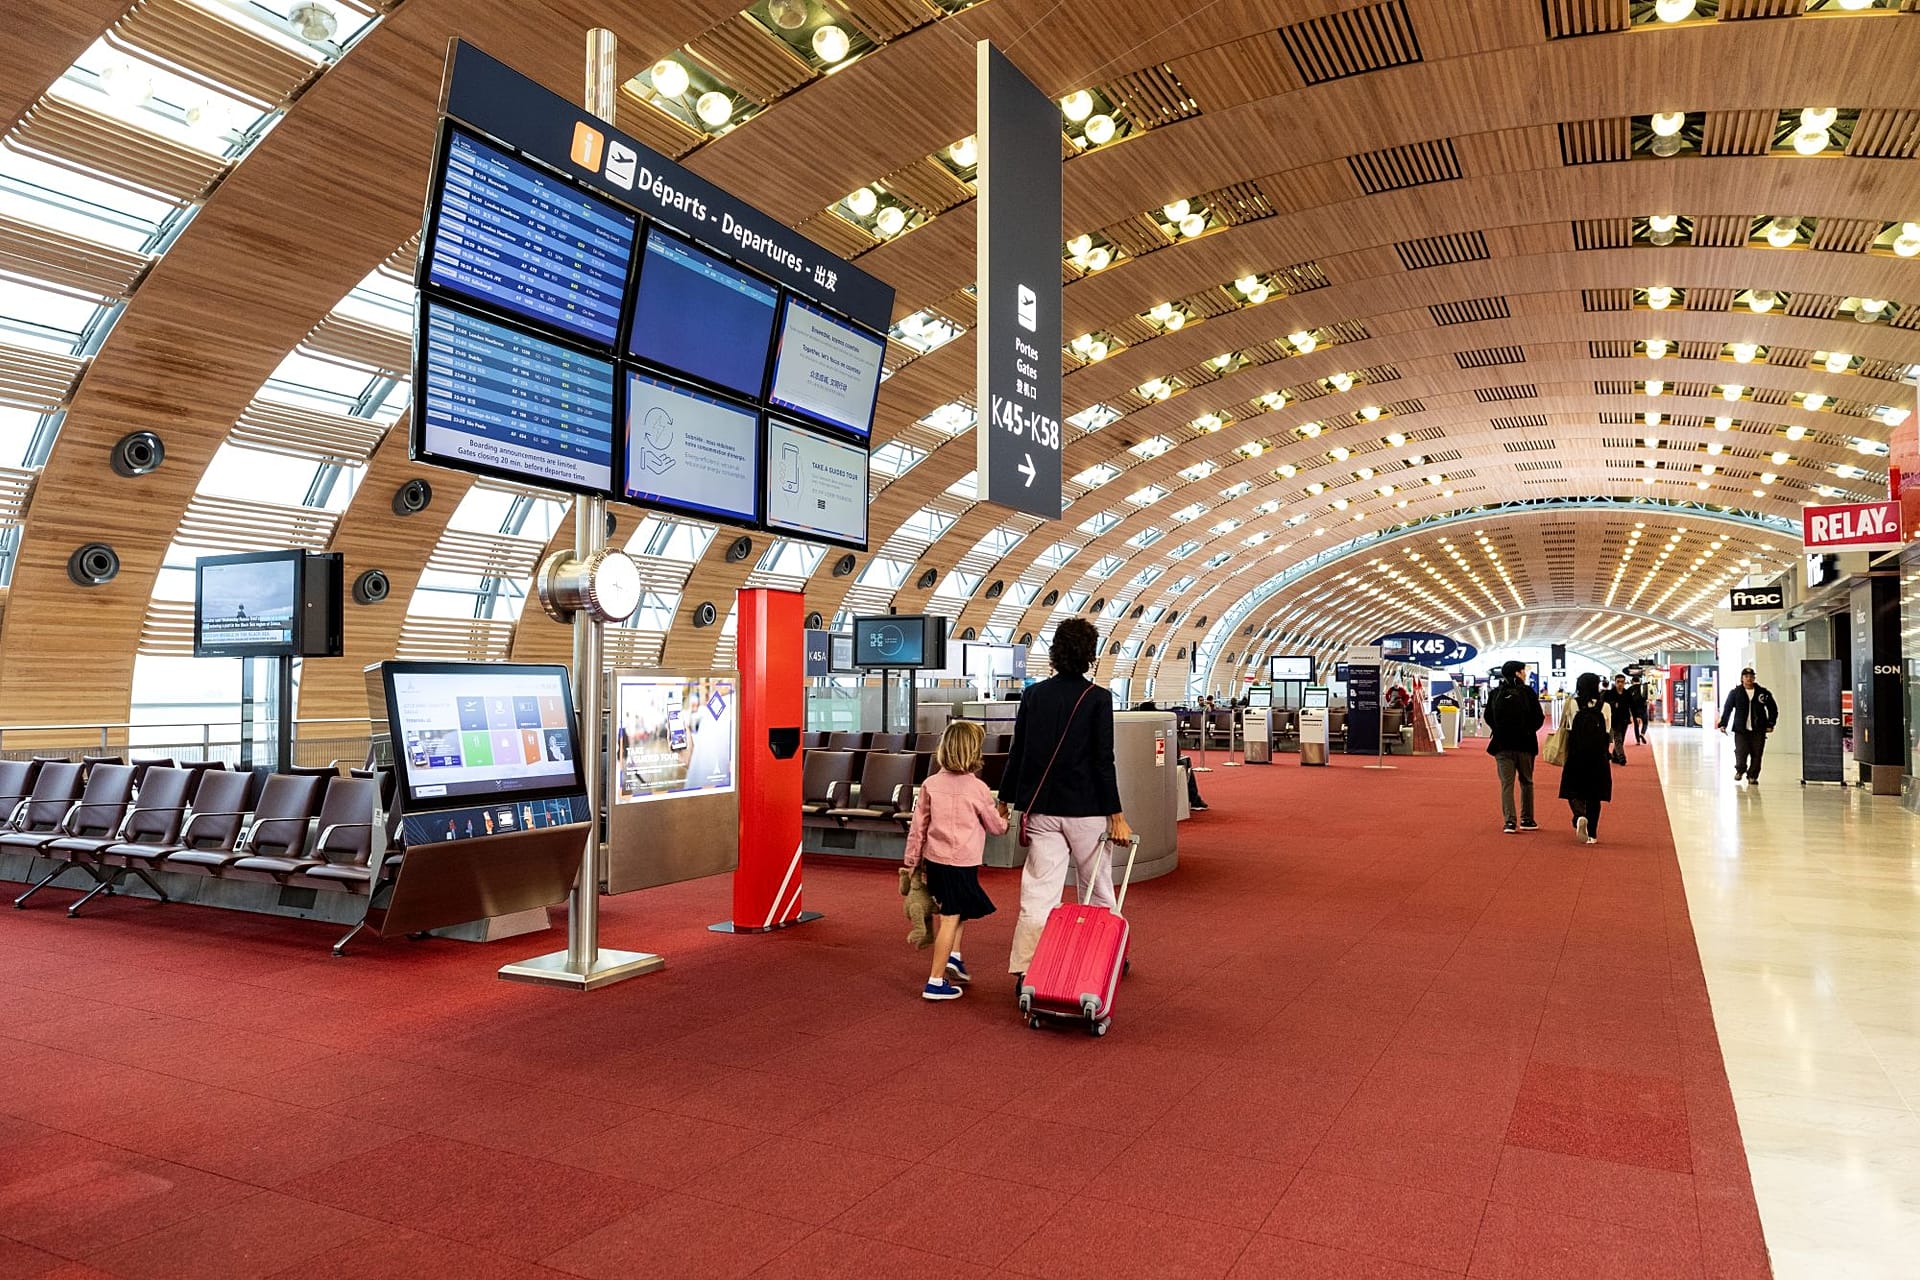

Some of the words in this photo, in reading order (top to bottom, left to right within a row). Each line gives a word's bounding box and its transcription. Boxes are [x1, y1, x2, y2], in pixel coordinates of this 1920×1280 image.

[638, 167, 707, 223] Départs
[721, 213, 803, 272] Departures
[814, 264, 838, 293] 出发
[1015, 337, 1039, 361] Portes
[1016, 358, 1038, 380] Gates
[1015, 378, 1037, 400] 登机口
[992, 394, 1060, 450] K45-K58
[457, 446, 476, 457] Gates
[477, 450, 499, 464] closing
[500, 456, 508, 464] 20
[509, 458, 522, 468] min.
[524, 461, 543, 472] before
[544, 466, 571, 480] departure
[469, 439, 497, 454] Boarding
[499, 446, 545, 463] announcements
[546, 457, 555, 465] are
[812, 461, 823, 471] TAKE
[1811, 507, 1888, 543] RELAY
[1732, 592, 1781, 606] fnac
[1412, 639, 1445, 654] K45
[1874, 665, 1901, 675] SON
[1805, 715, 1841, 726] fnac
